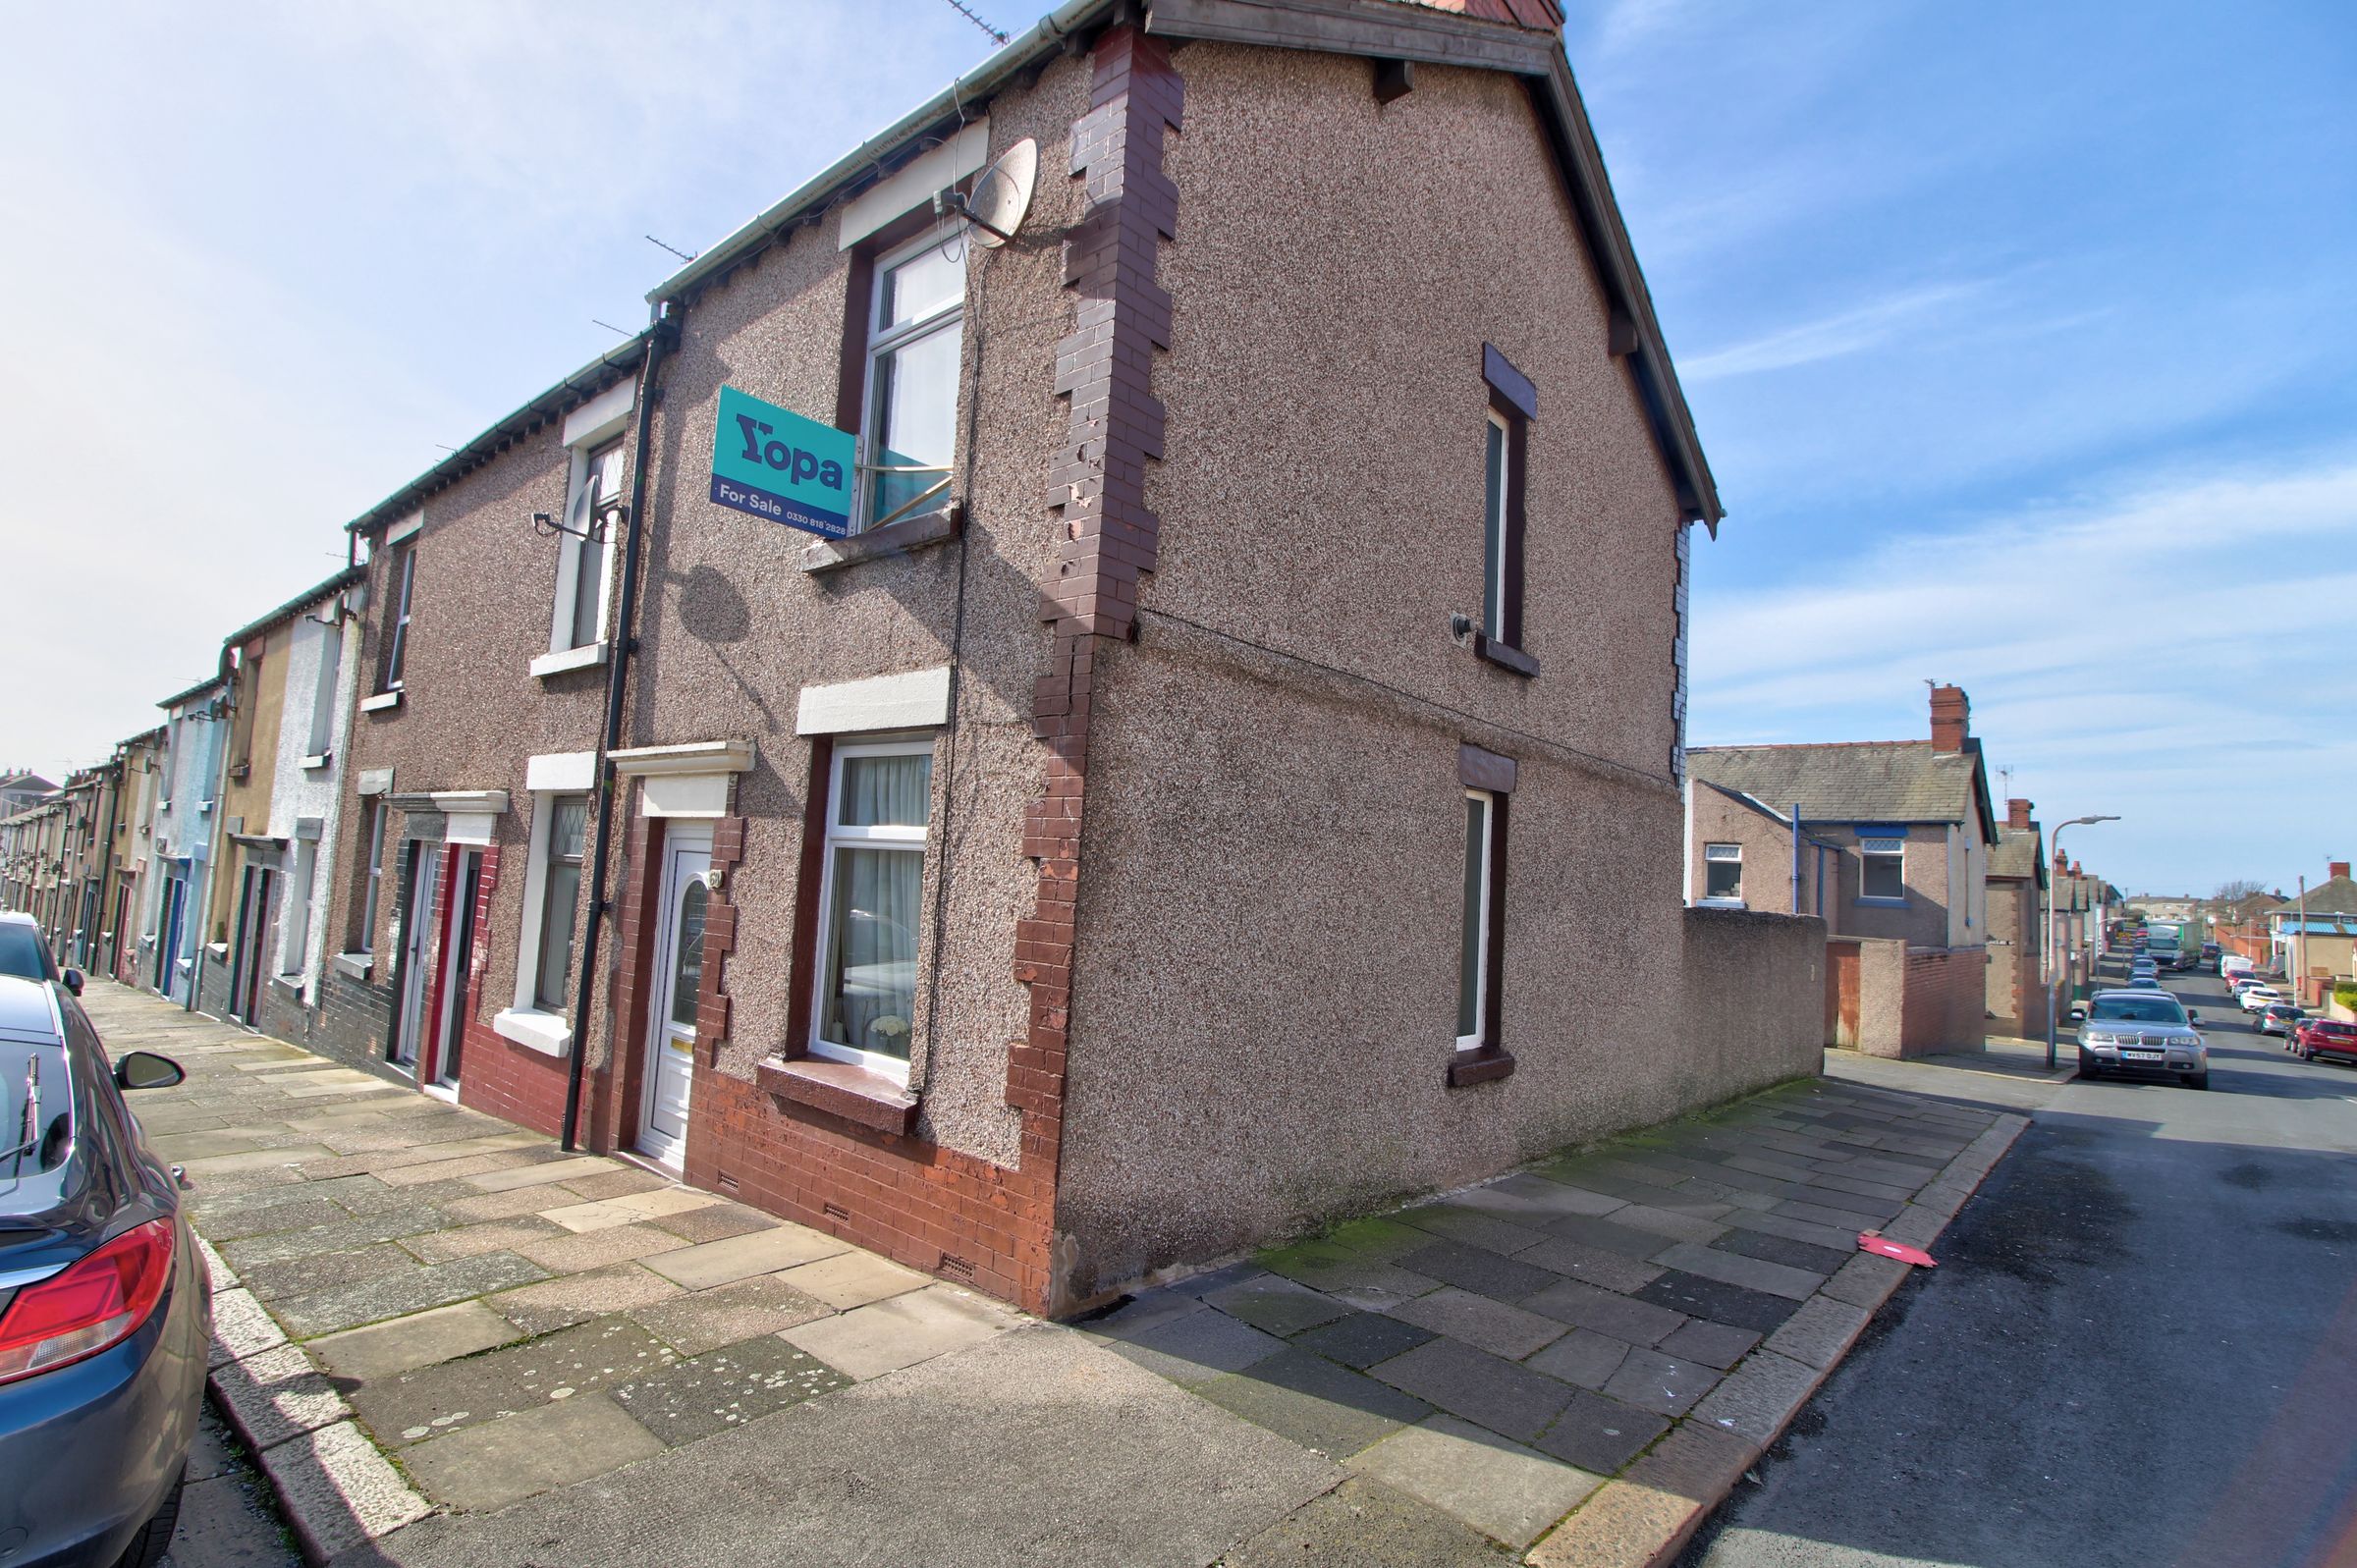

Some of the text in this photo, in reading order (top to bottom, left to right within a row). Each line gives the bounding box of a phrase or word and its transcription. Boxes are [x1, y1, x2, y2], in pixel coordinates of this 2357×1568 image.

[736, 413, 843, 491] Yopa
[720, 483, 782, 515] For Sale
[787, 512, 846, 535] 0330 818 2828
